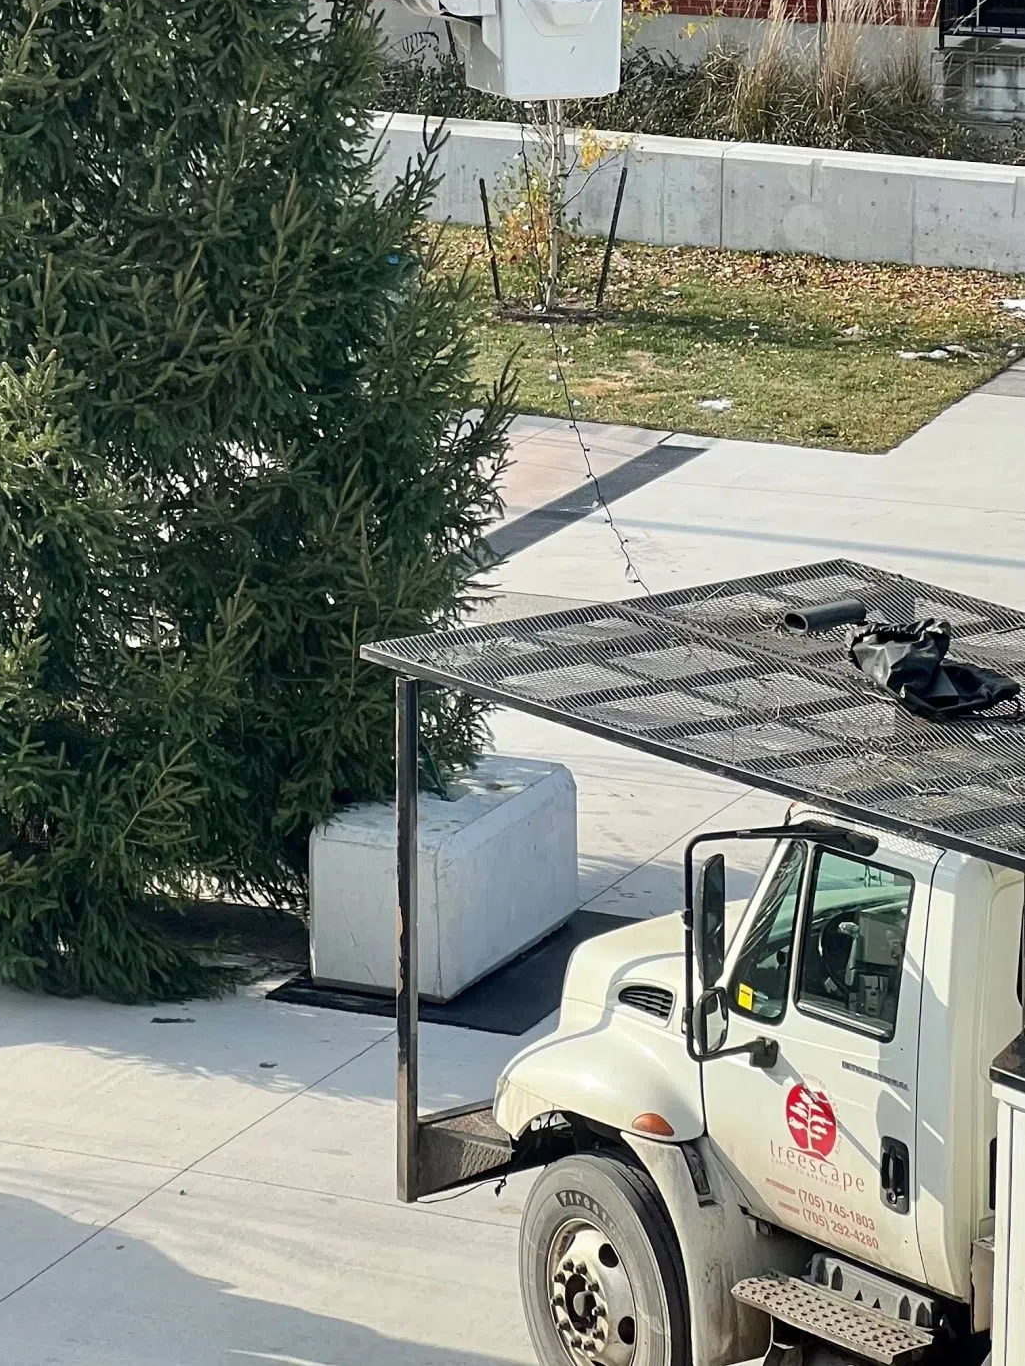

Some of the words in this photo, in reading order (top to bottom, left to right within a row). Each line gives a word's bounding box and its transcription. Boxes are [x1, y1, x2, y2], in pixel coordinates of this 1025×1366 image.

[770, 1139, 865, 1193] treescape
[798, 1189, 825, 1212] (705)
[826, 1200, 875, 1231] 745-1803
[803, 1208, 829, 1232] (705)
[830, 1220, 879, 1249] 292-4280
